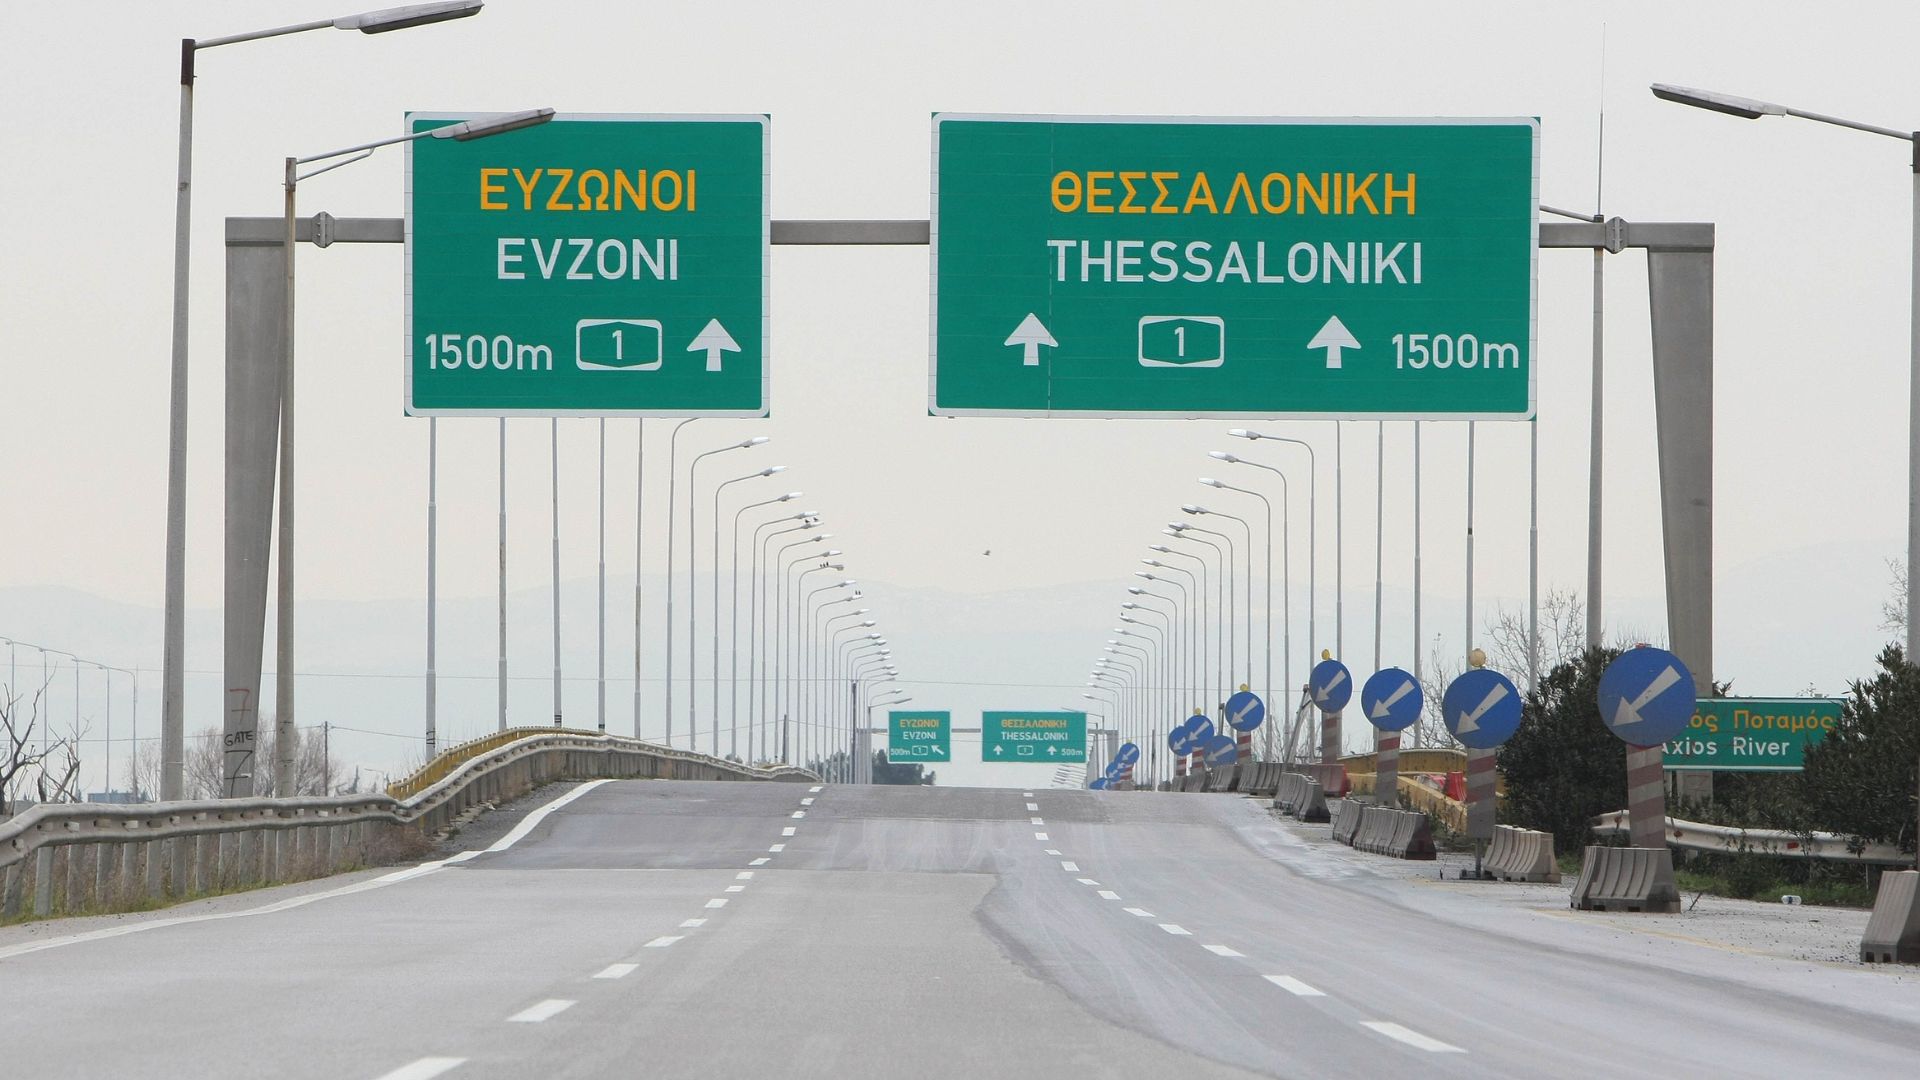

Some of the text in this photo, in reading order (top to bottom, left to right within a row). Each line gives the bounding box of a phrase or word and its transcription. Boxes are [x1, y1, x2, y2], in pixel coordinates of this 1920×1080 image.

[481, 168, 695, 211] ΕΥΖΩΝΟΙ
[1052, 171, 1415, 214] ΘΕΣΣΑΛΟΝΙΚΗ
[498, 238, 677, 280] EVZONI
[1047, 240, 1421, 283] THESSALONIKI
[426, 334, 552, 370] 1500m
[613, 330, 621, 359] 1
[1175, 327, 1184, 356] 1
[1393, 334, 1518, 368] 1500m
[899, 719, 940, 729] ΕΥΖΩΝΟΙ
[1001, 719, 1067, 729] ΘΕΣΣΑΛΟΝΙΚΗ
[1734, 710, 1834, 733] Ποταμός
[224, 731, 254, 746] GATE
[903, 731, 937, 740] EVZONI
[1001, 732, 1068, 741] THESSALONIKI
[1733, 737, 1790, 756] River
[889, 748, 911, 756] 500m
[1061, 748, 1083, 756] 500m
